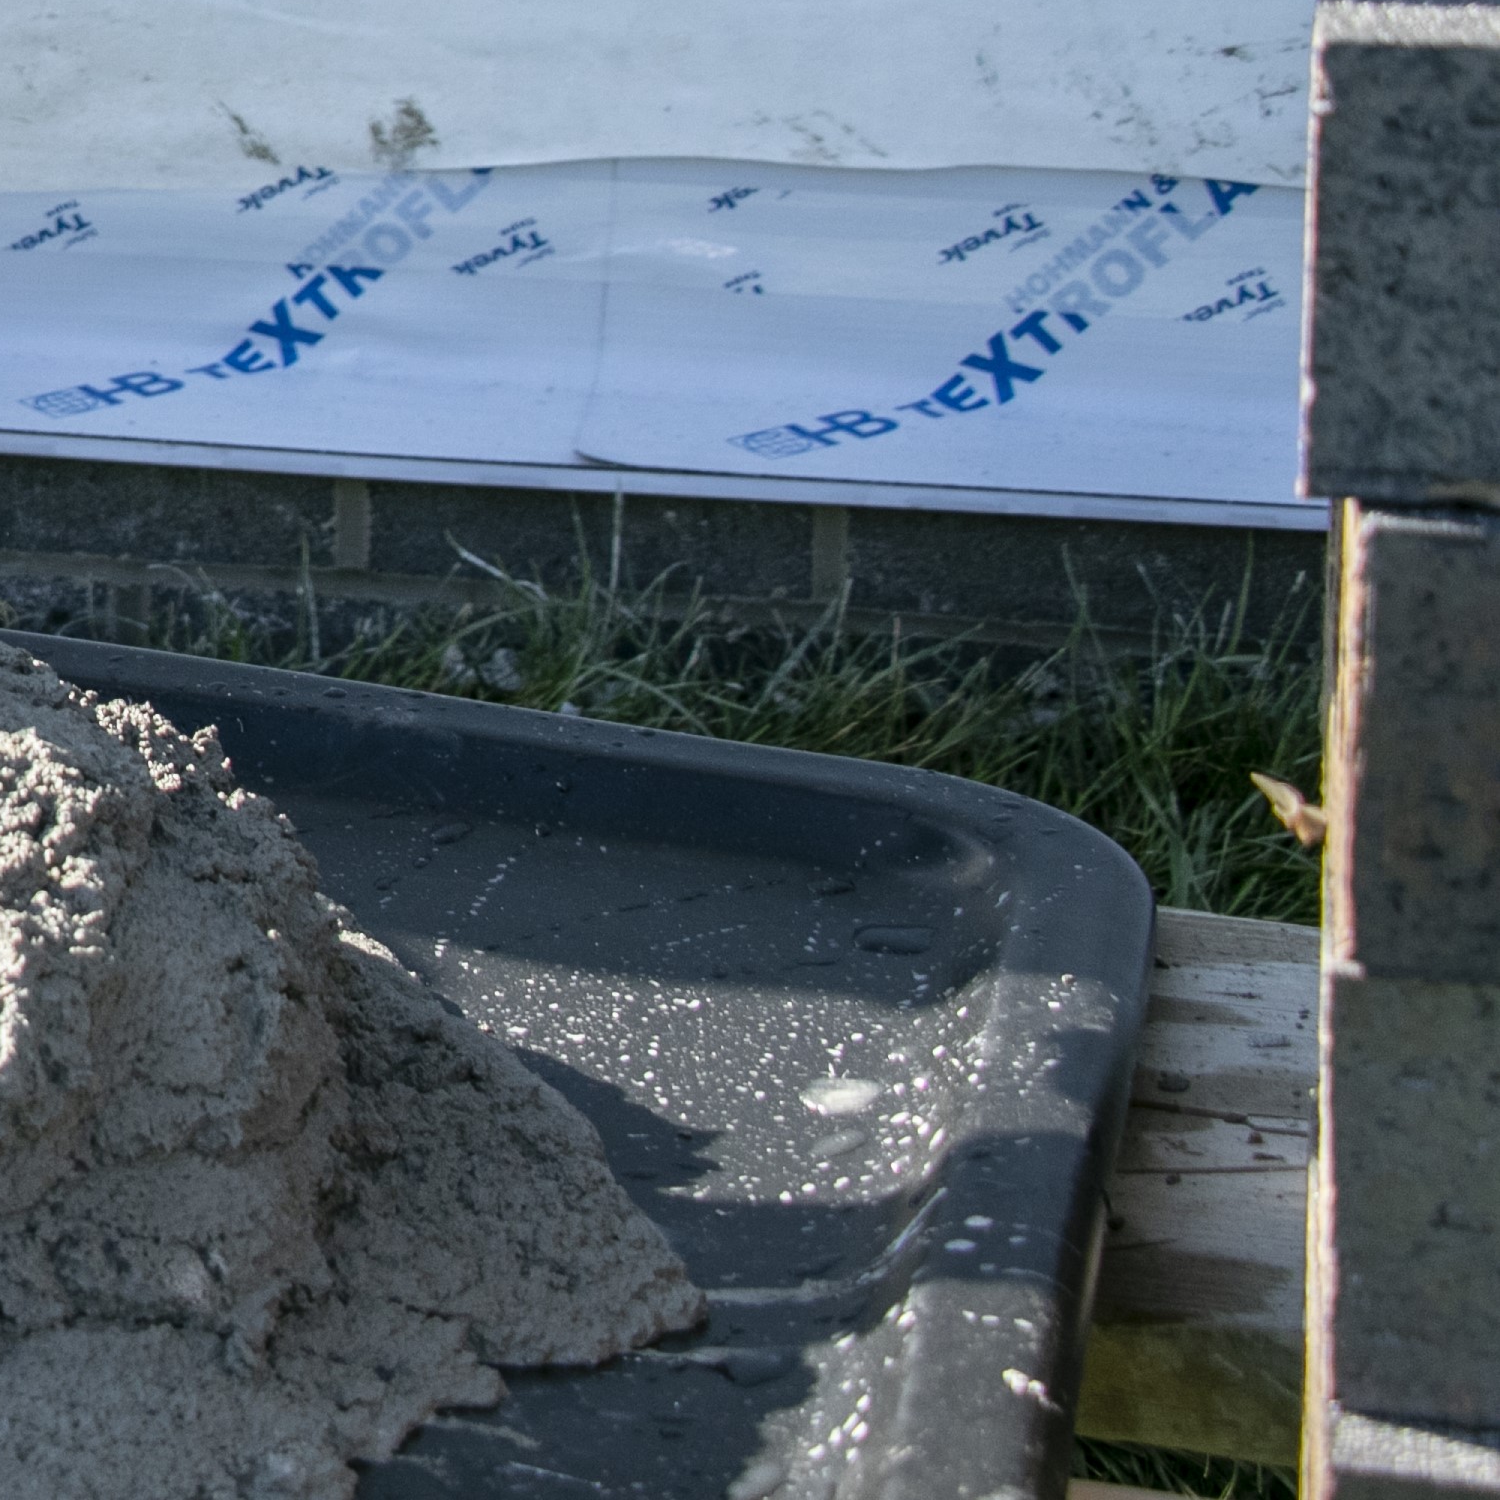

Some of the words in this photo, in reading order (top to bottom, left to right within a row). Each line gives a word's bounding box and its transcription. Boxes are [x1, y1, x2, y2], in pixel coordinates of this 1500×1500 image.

[235, 165, 335, 215] Tyvek
[450, 230, 550, 277] Tyvek
[937, 211, 1045, 265] Tyvek
